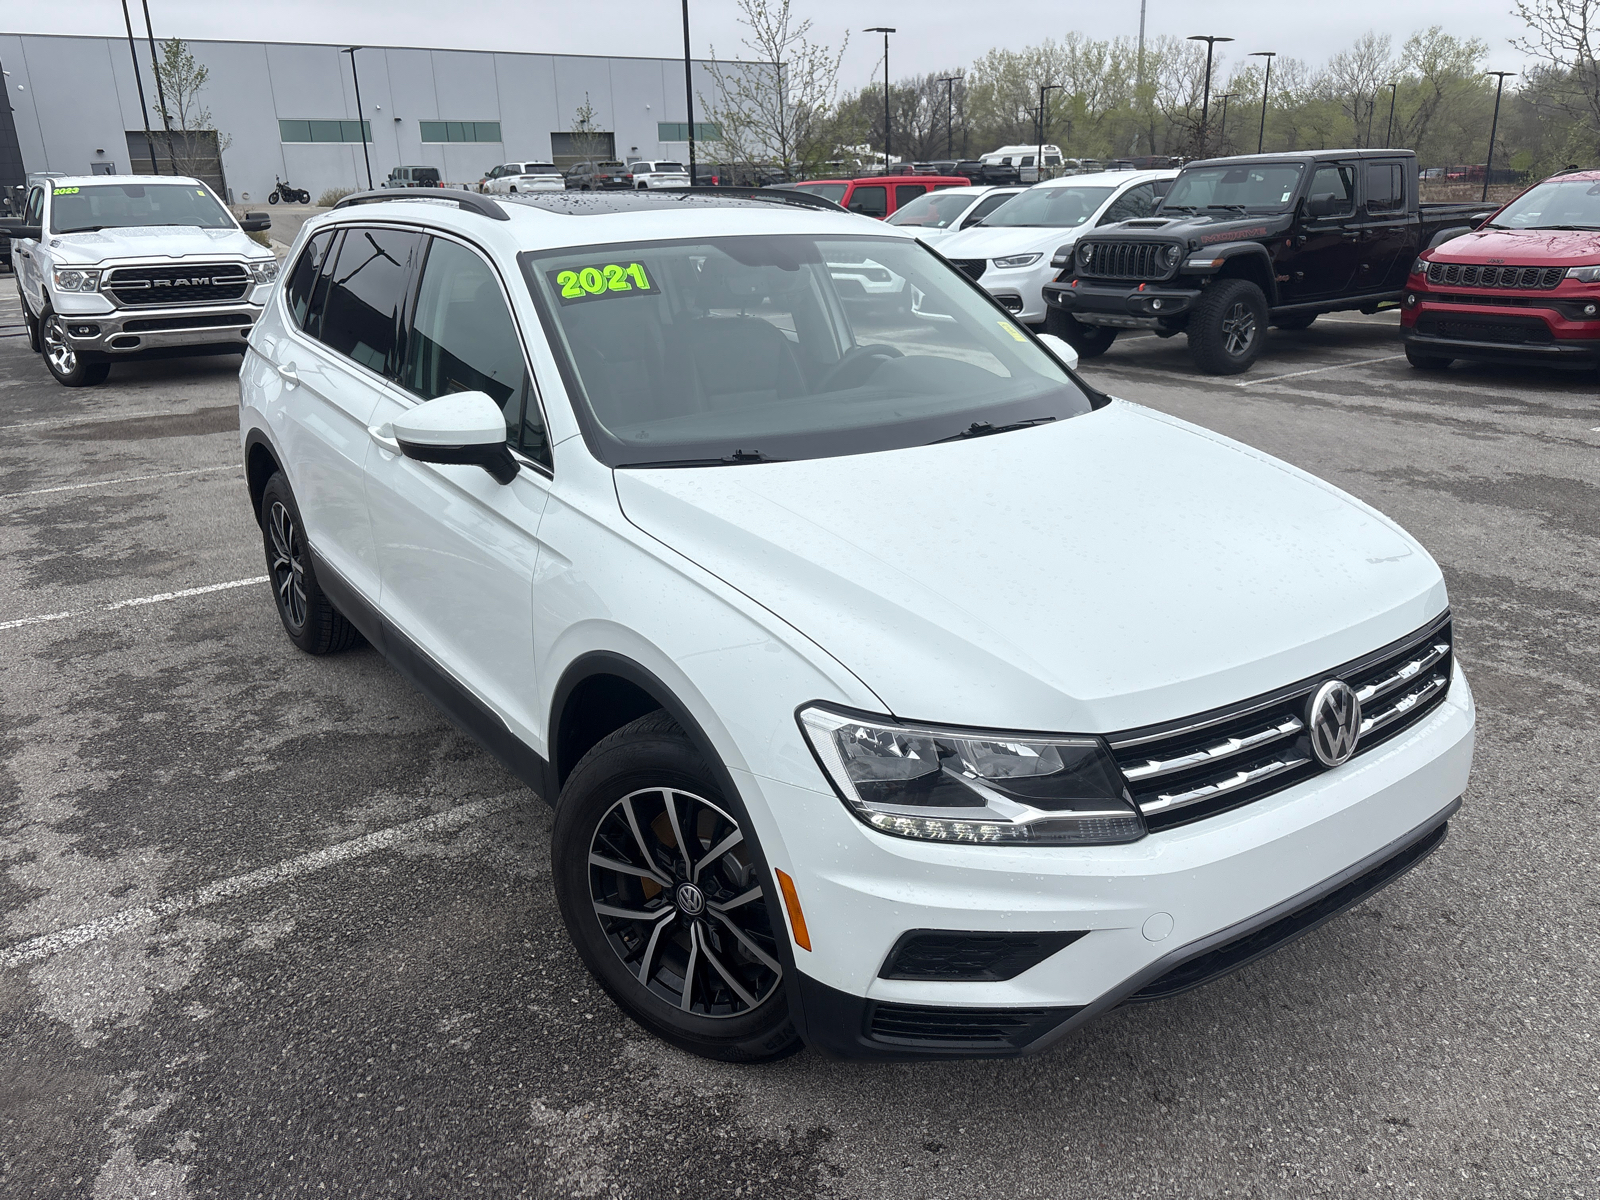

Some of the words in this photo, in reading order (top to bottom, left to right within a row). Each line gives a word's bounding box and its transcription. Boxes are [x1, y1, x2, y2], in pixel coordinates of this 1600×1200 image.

[53, 187, 80, 196] 2023
[1201, 227, 1267, 244] MOJAVE
[153, 277, 209, 288] RAM
[557, 263, 650, 299] 2021
